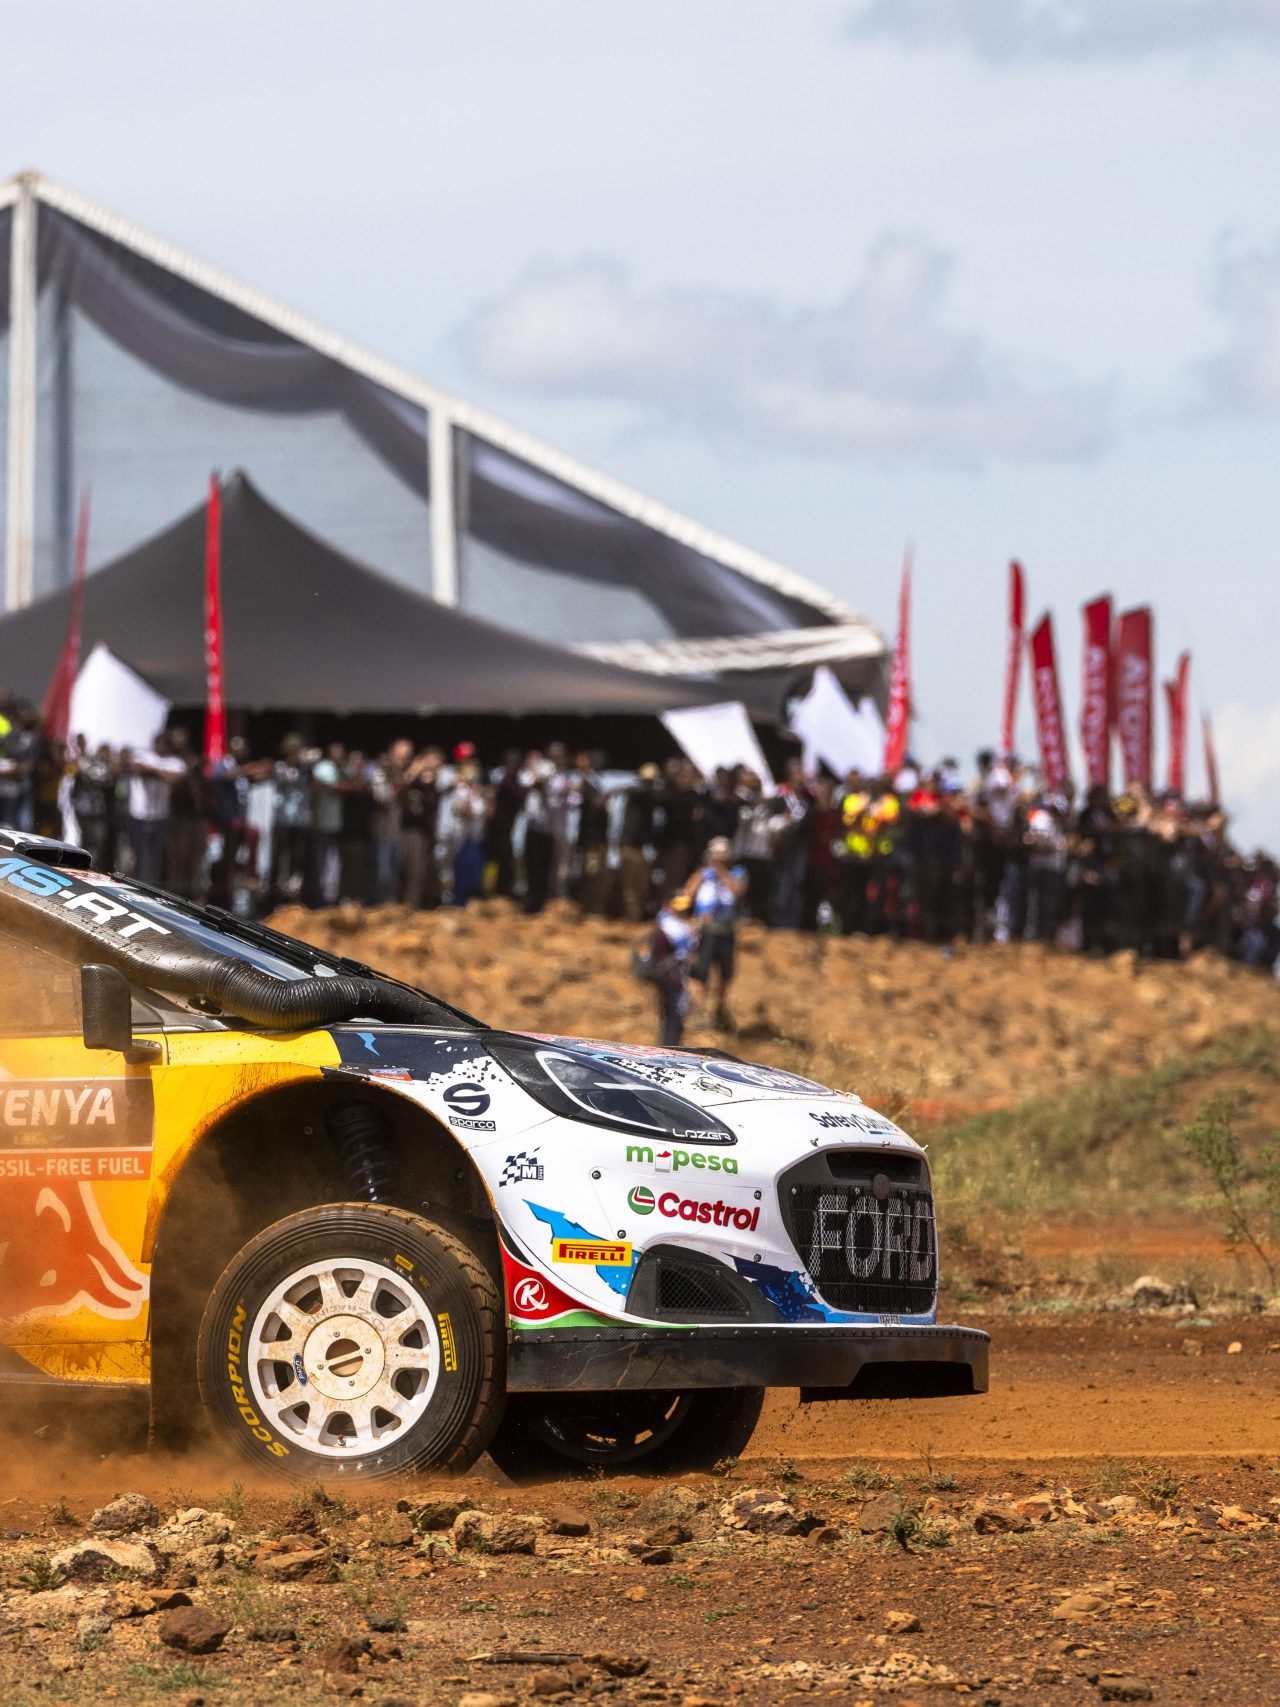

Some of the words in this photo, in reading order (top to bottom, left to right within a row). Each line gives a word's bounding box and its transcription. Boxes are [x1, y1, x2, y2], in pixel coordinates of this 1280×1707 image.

[450, 1117, 495, 1130] sparco
[672, 1127, 732, 1141] LAZER
[98, 1157, 145, 1175] FUEL
[658, 1192, 761, 1232] Castrol
[808, 1193, 934, 1281] FORD
[559, 1243, 626, 1262] PIRELLI
[437, 1312, 458, 1372] PIRELLI
[227, 1304, 290, 1457] SCORPION
